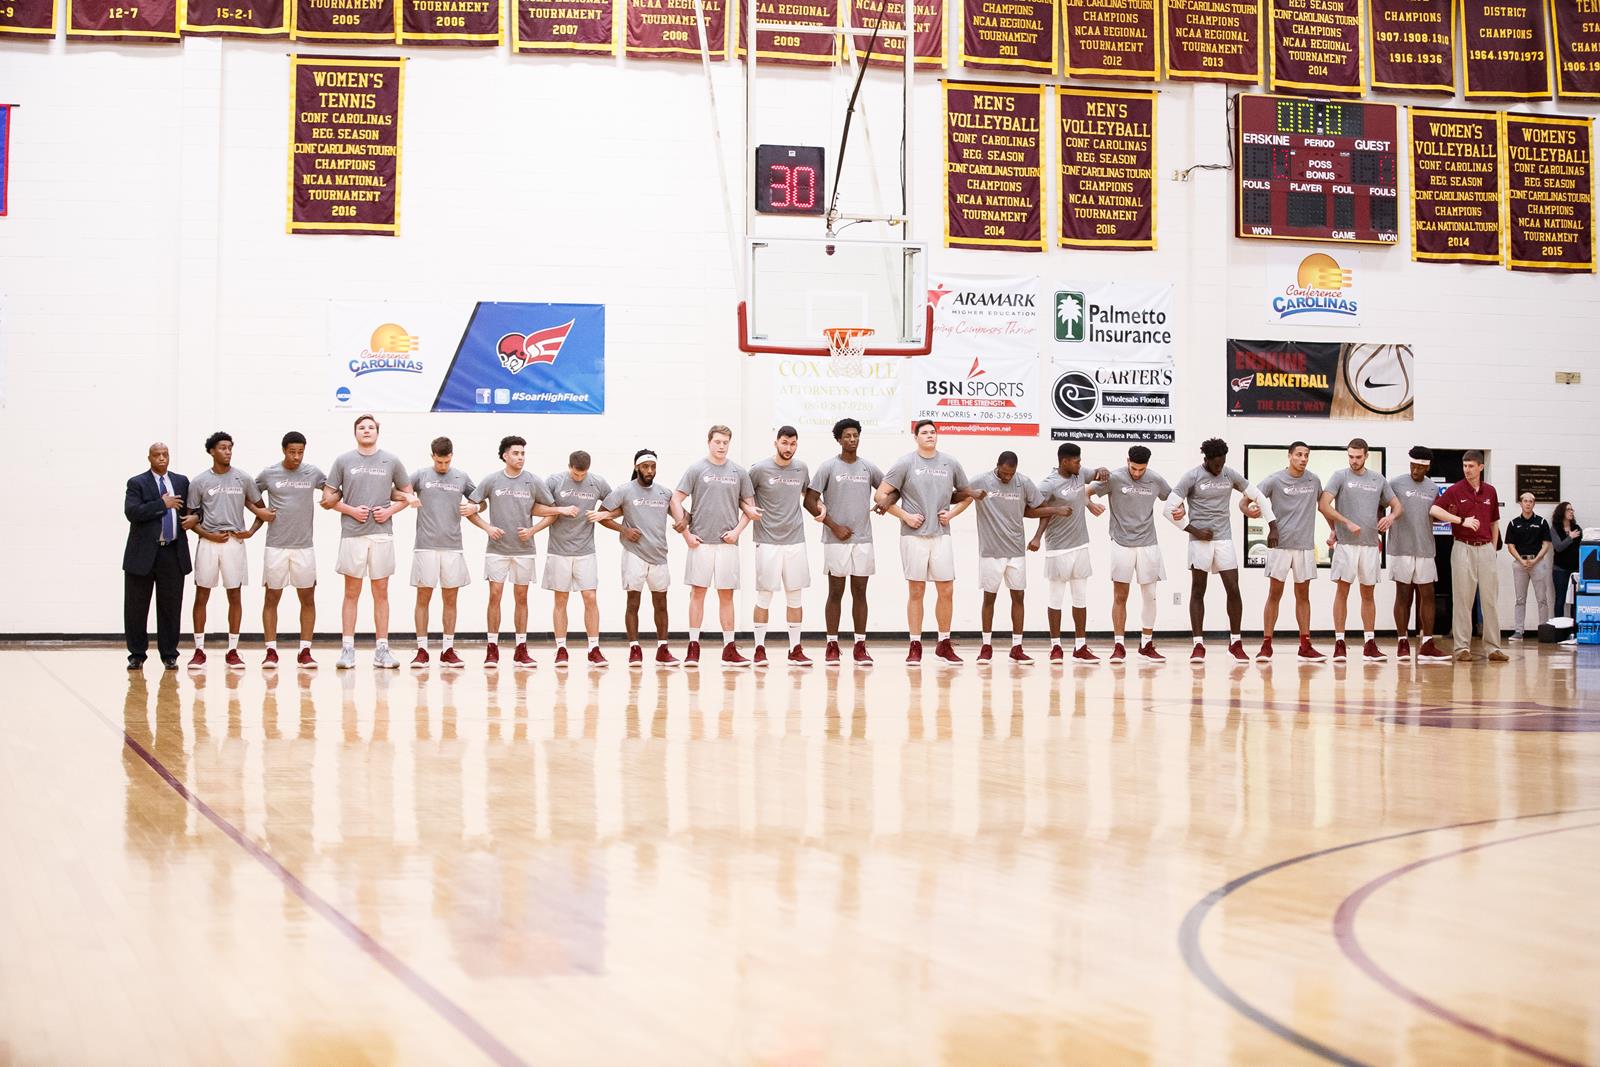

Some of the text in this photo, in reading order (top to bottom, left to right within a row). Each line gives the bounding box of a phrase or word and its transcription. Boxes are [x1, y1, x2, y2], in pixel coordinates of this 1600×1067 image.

[310, 0, 383, 9] TOURNAMENT
[413, 1, 489, 12] TOURNAMENT
[633, 0, 662, 8] NCAA
[983, 3, 1033, 16] CHAMPIONS
[1311, 0, 1344, 12] SEASON
[109, 8, 138, 18] 12-7
[217, 8, 252, 19] 15-2-1
[529, 8, 602, 20] TOURNAMENT
[778, 4, 830, 17] REGIONAL
[1385, 11, 1442, 22] CHAMPIONS
[1484, 6, 1526, 17] DISTRICT
[332, 15, 360, 25] 2005
[436, 16, 465, 26] 2006
[973, 16, 1043, 30] NCAA REGIONAL
[1083, 12, 1139, 23] CHAMPIONS
[1186, 15, 1239, 27] CHAMPIONS
[1294, 11, 1334, 24] CAROLINAS
[552, 25, 578, 35] 2007
[662, 31, 688, 41] 2008
[1075, 26, 1147, 38] NCAA REGIONAL
[1176, 28, 1249, 42] NCAA REGIONAL
[1293, 25, 1342, 38] CHAMPIONS
[1480, 28, 1533, 39] CHAMPIONS
[774, 36, 800, 47] 2009
[979, 30, 1038, 44] TOURNAMENT
[1080, 40, 1144, 52] TOURNAMENT
[1182, 42, 1243, 54] TOURNAMENT
[1283, 37, 1352, 52] NCAA REGIONAL
[1000, 46, 1018, 56] 2011
[1102, 55, 1122, 66] 2012
[1202, 57, 1224, 67] 2013
[1289, 51, 1347, 65] TOURNAMENT
[1308, 66, 1328, 76] 2014
[313, 71, 384, 88] WOMEN'S
[319, 92, 376, 109] TENNIS
[974, 95, 1015, 111] MEN'S
[1087, 102, 1127, 118] MEN'S
[332, 113, 392, 125] CAROLINAS
[949, 112, 1039, 132] VOLLEYBALL
[312, 128, 379, 140] REG. SEASON
[1062, 119, 1150, 138] VOLLEYBALL
[1429, 123, 1482, 139] WOMEN'S
[982, 134, 1035, 147] CAROLINAS
[1243, 134, 1290, 146] ERSKINE
[1522, 128, 1576, 144] WOMEN'S
[318, 144, 366, 155] CAROLINAS
[1094, 139, 1147, 151] CAROLINAS
[1304, 139, 1335, 148] PERIOD
[1355, 140, 1390, 151] GUEST
[1415, 141, 1496, 158] VOLLEYBALL
[963, 148, 1024, 162] REG. SEASON
[1076, 152, 1137, 165] REG. SEASON
[1509, 146, 1589, 163] VOLLEYBALL
[315, 159, 375, 170] CHAMPIONS
[969, 163, 1013, 176] CAROLINAS
[1309, 160, 1332, 169] POSS
[1445, 162, 1493, 172] CAROLINAS
[1539, 165, 1585, 175] CAROLINAS
[1082, 165, 1124, 177] CAROLINAS
[1306, 171, 1335, 180] BONUS
[303, 175, 386, 187] NCAA NATIONAL
[771, 165, 815, 208] 30
[967, 179, 1022, 192] CHAMPIONS
[1079, 180, 1134, 192] CHAMPIONS
[1243, 180, 1270, 189] FOULS
[1451, 177, 1482, 186] SEASON
[1544, 178, 1575, 189] SEASON
[1290, 183, 1354, 194] PLAYER FOUL
[1370, 188, 1396, 196] FOULS
[308, 190, 381, 202] TOURNAMENT
[957, 193, 1032, 208] NCAA NATIONAL
[1069, 193, 1143, 207] NCAA NATIONAL
[1434, 192, 1474, 201] CAROLINAS
[1529, 191, 1568, 201] CAROLINAS
[332, 205, 357, 216] 2016
[962, 209, 1027, 222] TOURNAMENT
[1075, 208, 1138, 221] TOURNAMENT
[1435, 207, 1482, 216] CHAMPIONS
[1528, 204, 1574, 215] CHAMPIONS
[1096, 224, 1116, 234] 2016
[1416, 221, 1475, 231] NCAA NATIONAL
[1519, 217, 1584, 230] NCAA NATIONAL
[984, 225, 1005, 236] 2014
[1252, 227, 1272, 235] WON
[1332, 231, 1356, 240] GAME
[1448, 237, 1469, 247] 2014
[1524, 231, 1578, 243] TOURNAMENT
[1542, 247, 1563, 256] 2015
[1286, 284, 1342, 298] Conference
[952, 292, 1036, 307] ARAMARK
[1273, 297, 1357, 312] CAROLINAS
[1089, 304, 1166, 324] Palmetto
[1090, 324, 1171, 343] Insurance
[349, 359, 423, 372] CAROLINAS
[1235, 351, 1306, 372] ERSKINE
[1095, 367, 1172, 386] CARTER'S
[1256, 372, 1329, 388] BASKETBALL
[927, 381, 1024, 397] BSN SPORTS
[512, 392, 589, 403] #SoarHighFleet
[1140, 396, 1166, 405] Flooring
[1304, 402, 1325, 412] WAY
[980, 412, 1032, 420] 706-376-5595
[1095, 413, 1172, 425] 864-369-0911
